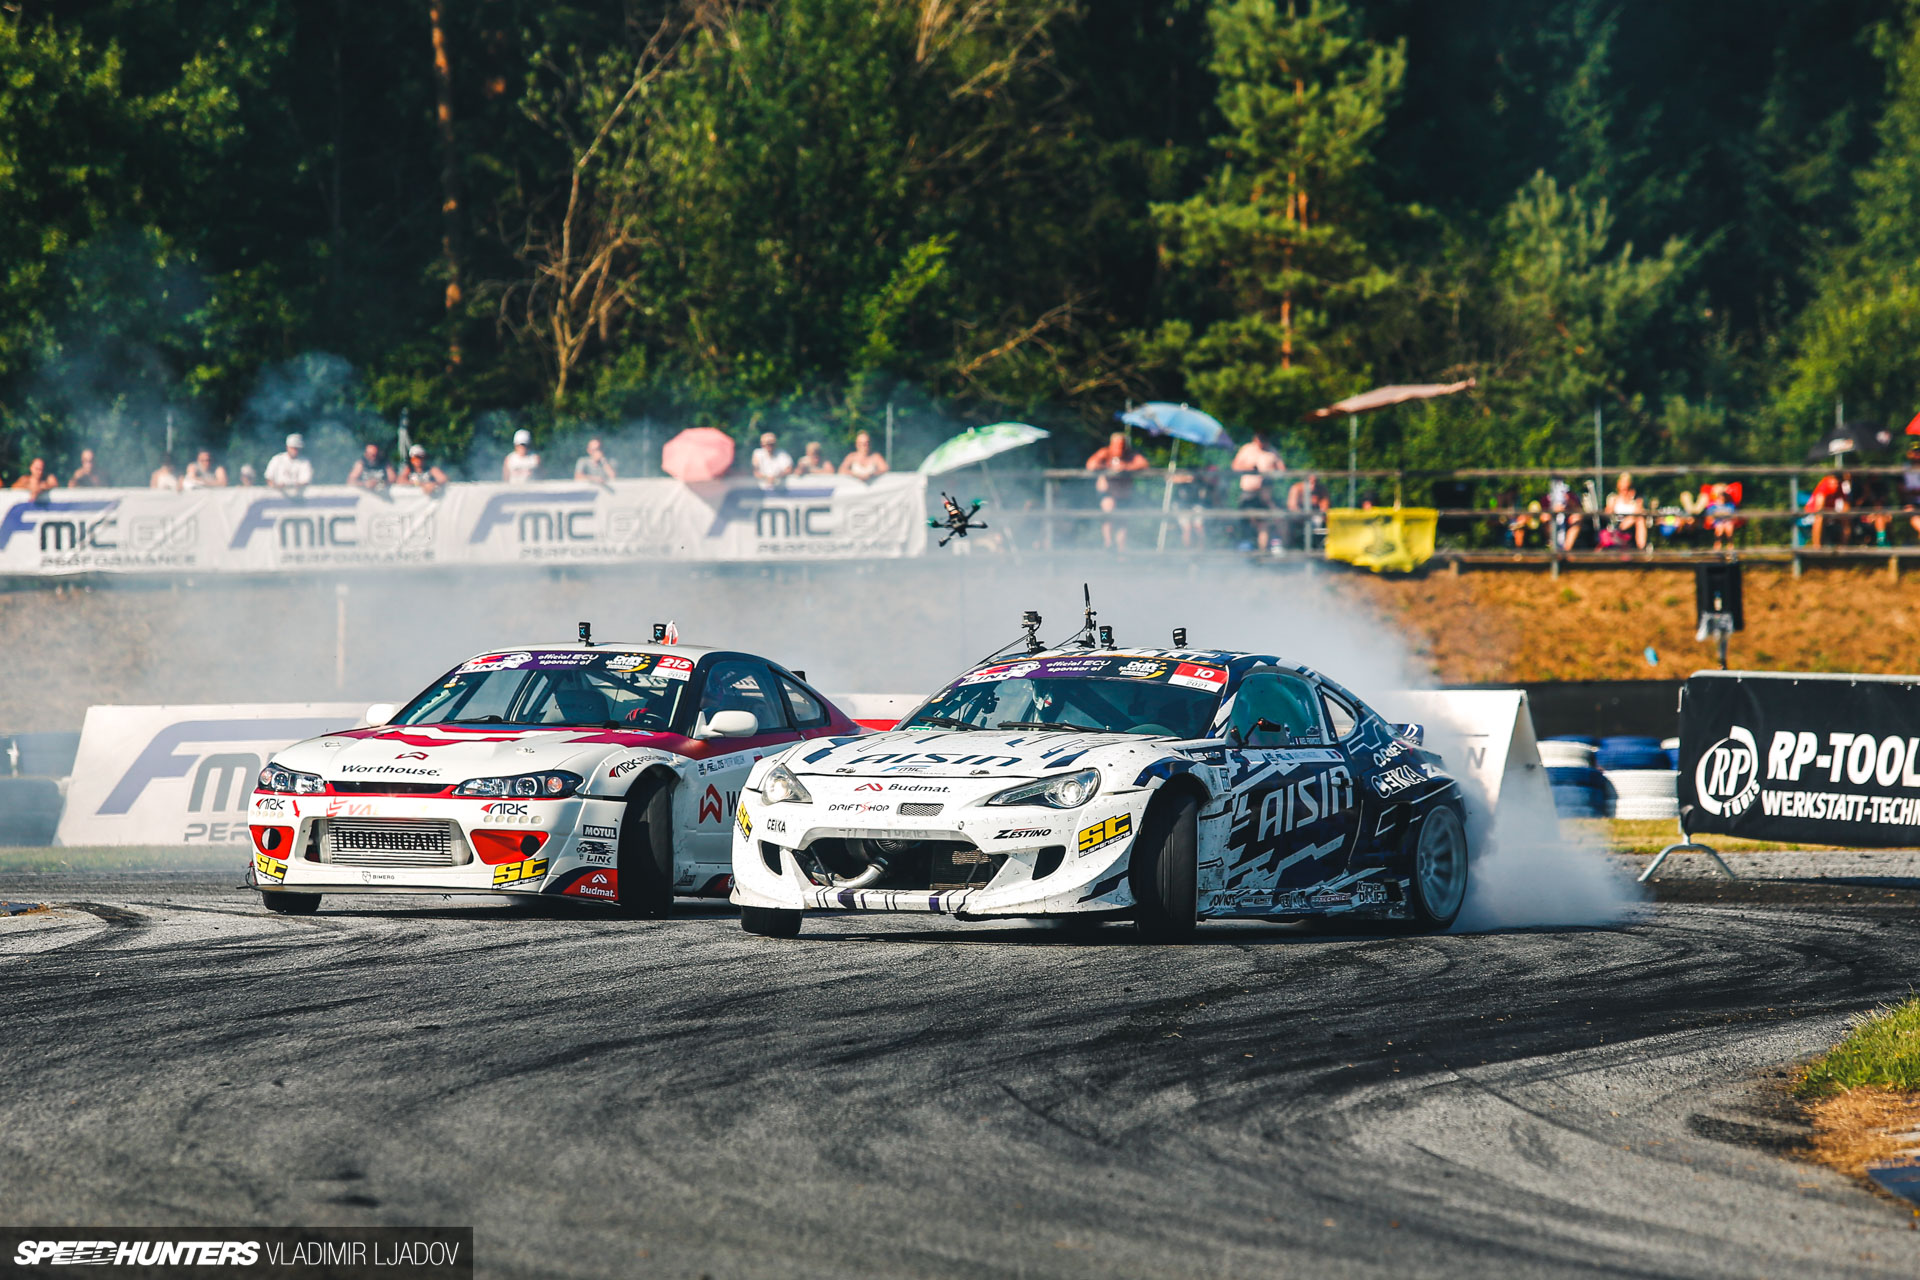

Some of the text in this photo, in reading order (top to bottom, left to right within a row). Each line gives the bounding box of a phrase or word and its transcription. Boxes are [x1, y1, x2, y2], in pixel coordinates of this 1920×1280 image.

[659, 658, 692, 669] 215
[1046, 661, 1081, 669] official
[1194, 668, 1215, 679] 10
[1185, 680, 1208, 688] 2021
[1708, 748, 1751, 796] RP
[1371, 764, 1427, 799] CEIKA
[1723, 779, 1761, 818] TOOLS
[481, 803, 528, 815] ARK
[767, 818, 786, 833] CEIKA
[584, 826, 616, 838] MOTUL
[993, 828, 1052, 840] ZESTINO
[580, 885, 616, 897] Budmat.
